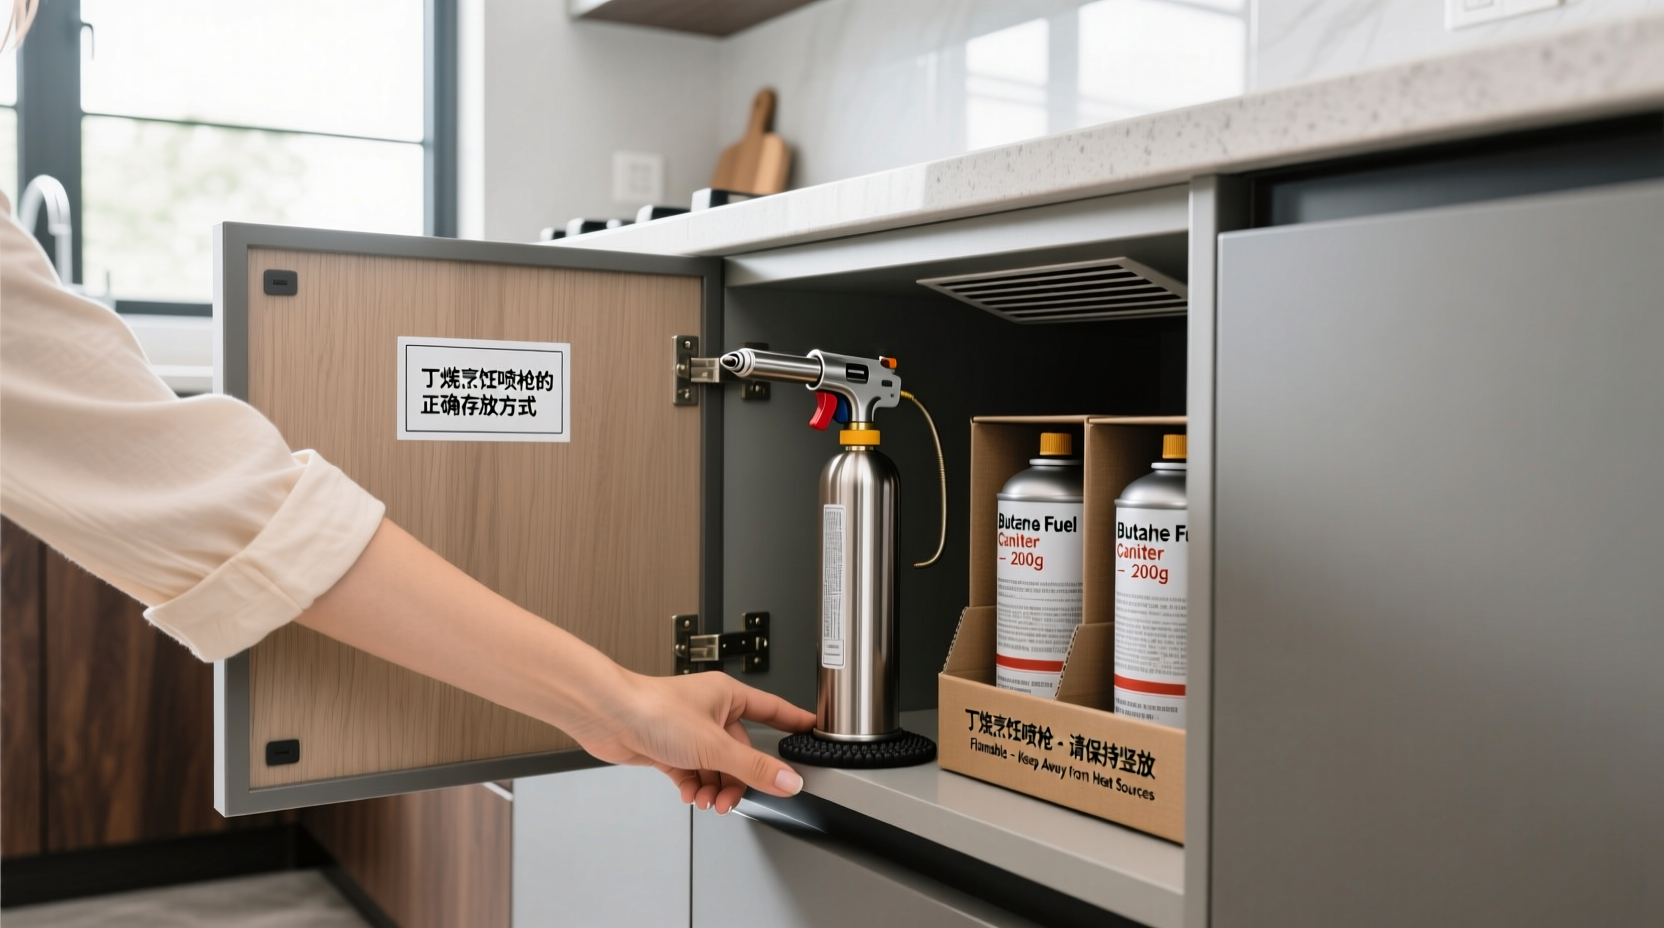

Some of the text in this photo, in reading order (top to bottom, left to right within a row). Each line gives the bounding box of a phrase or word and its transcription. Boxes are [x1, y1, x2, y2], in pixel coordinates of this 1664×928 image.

[420, 393, 537, 417] 正确存放方式
[1044, 515, 1078, 533] Fuel
[1010, 551, 1045, 572] 200g
[1130, 563, 1169, 585] 200g
[1069, 733, 1156, 780] 请保持竖放
